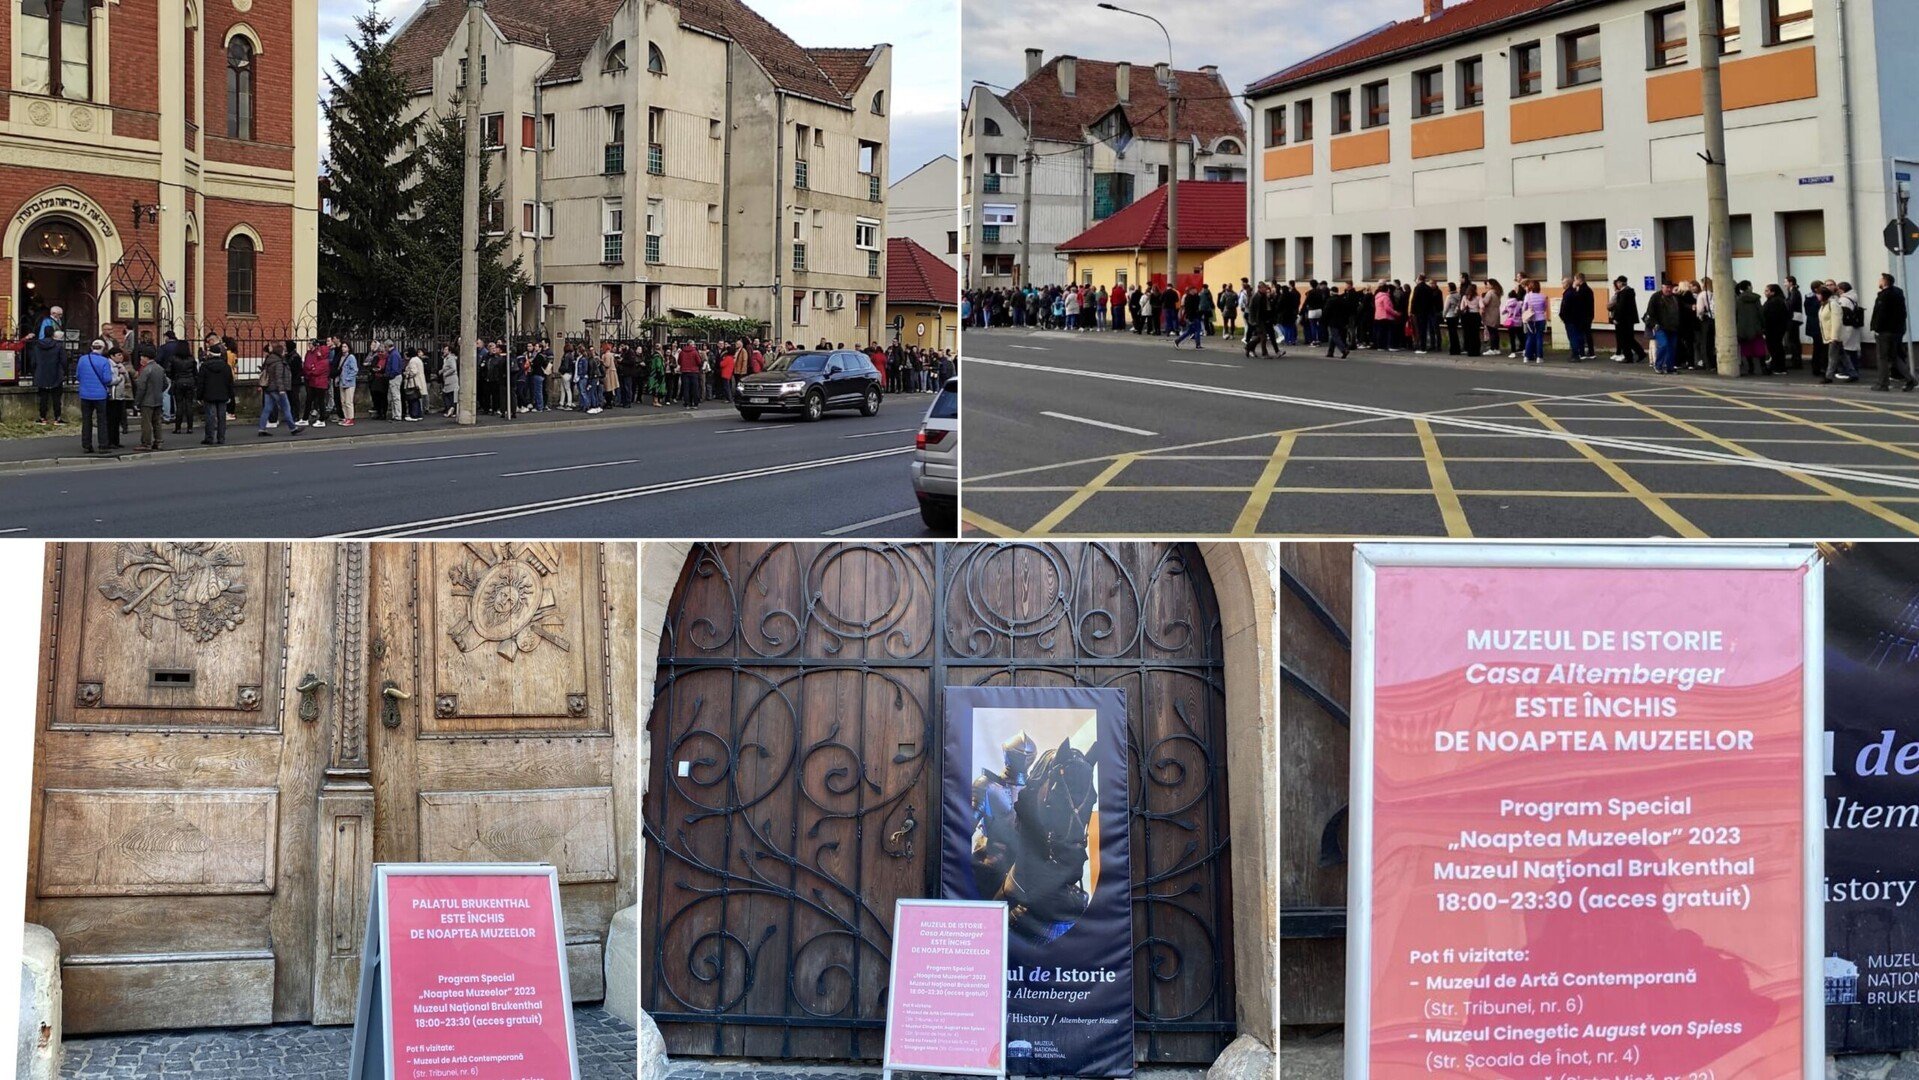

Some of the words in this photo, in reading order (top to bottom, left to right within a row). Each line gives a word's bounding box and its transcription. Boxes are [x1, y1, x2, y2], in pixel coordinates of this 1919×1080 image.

[1467, 630, 1575, 652] MUZEUL
[1582, 630, 1615, 652] DE
[1622, 630, 1723, 652] ISTORIE
[1466, 663, 1539, 685] Casa
[1546, 662, 1724, 692] Altemberger
[1515, 697, 1577, 719] ESTE
[1584, 692, 1677, 718] ÎNCHIS
[1435, 730, 1470, 752] DE
[1477, 729, 1608, 752] NOAPTEA
[1615, 729, 1754, 751] MUZEELOR
[1855, 729, 1919, 776] de
[1500, 799, 1602, 821] Program
[1608, 795, 1691, 821] Special
[1688, 827, 1741, 846] 2023
[1434, 860, 1518, 881] Muzeul
[1629, 857, 1755, 877] Brukenthal
[1578, 887, 1657, 914] (acces
[1662, 885, 1751, 911] gratuit)
[1824, 877, 1917, 907] istory
[413, 899, 459, 908] PALATUL
[462, 899, 530, 908] BRUKENTHAL
[441, 914, 465, 923] ESTE
[468, 912, 504, 923] ÎNCHIS
[411, 929, 424, 939] DE
[427, 929, 478, 938] NOAPTEA
[481, 928, 536, 937] MUZEELOR
[1410, 950, 1439, 964] Pot
[1443, 950, 1454, 963] fi
[1458, 949, 1529, 963] vizitate:
[438, 975, 479, 985] Program
[481, 974, 515, 984] Special
[1029, 967, 1050, 982] de
[1055, 967, 1116, 982] Istorie
[1427, 976, 1489, 990] Muzeul
[1494, 974, 1516, 988] de
[1521, 972, 1558, 987] Artă
[1563, 969, 1697, 989] Contemporană
[515, 987, 536, 995] 2023
[1014, 988, 1090, 1002] Altemberger
[1868, 990, 1919, 1004] BRUKE
[414, 1004, 447, 1013] Muzeul
[492, 1001, 542, 1011] Brukenthal
[1424, 999, 1458, 1019] (Str.
[1463, 999, 1535, 1016] Tribunei,
[1540, 1001, 1561, 1013] nr.
[1566, 995, 1584, 1014] 6)
[473, 1017, 504, 1028] (acces
[506, 1015, 542, 1027] gratuit)
[1012, 1013, 1049, 1025] History
[1426, 1028, 1489, 1043] Muzeul
[1494, 1024, 1579, 1044] Cinegetic
[1582, 1023, 1647, 1040] August
[1650, 1024, 1682, 1036] von
[1687, 1021, 1742, 1037] Spiess
[414, 1057, 440, 1065] Muzeul
[1426, 1052, 1460, 1072] (Str.
[1529, 1051, 1551, 1066] de
[1556, 1047, 1592, 1068] Înot,
[1597, 1049, 1618, 1063] nr.
[1622, 1045, 1640, 1065] 4)
